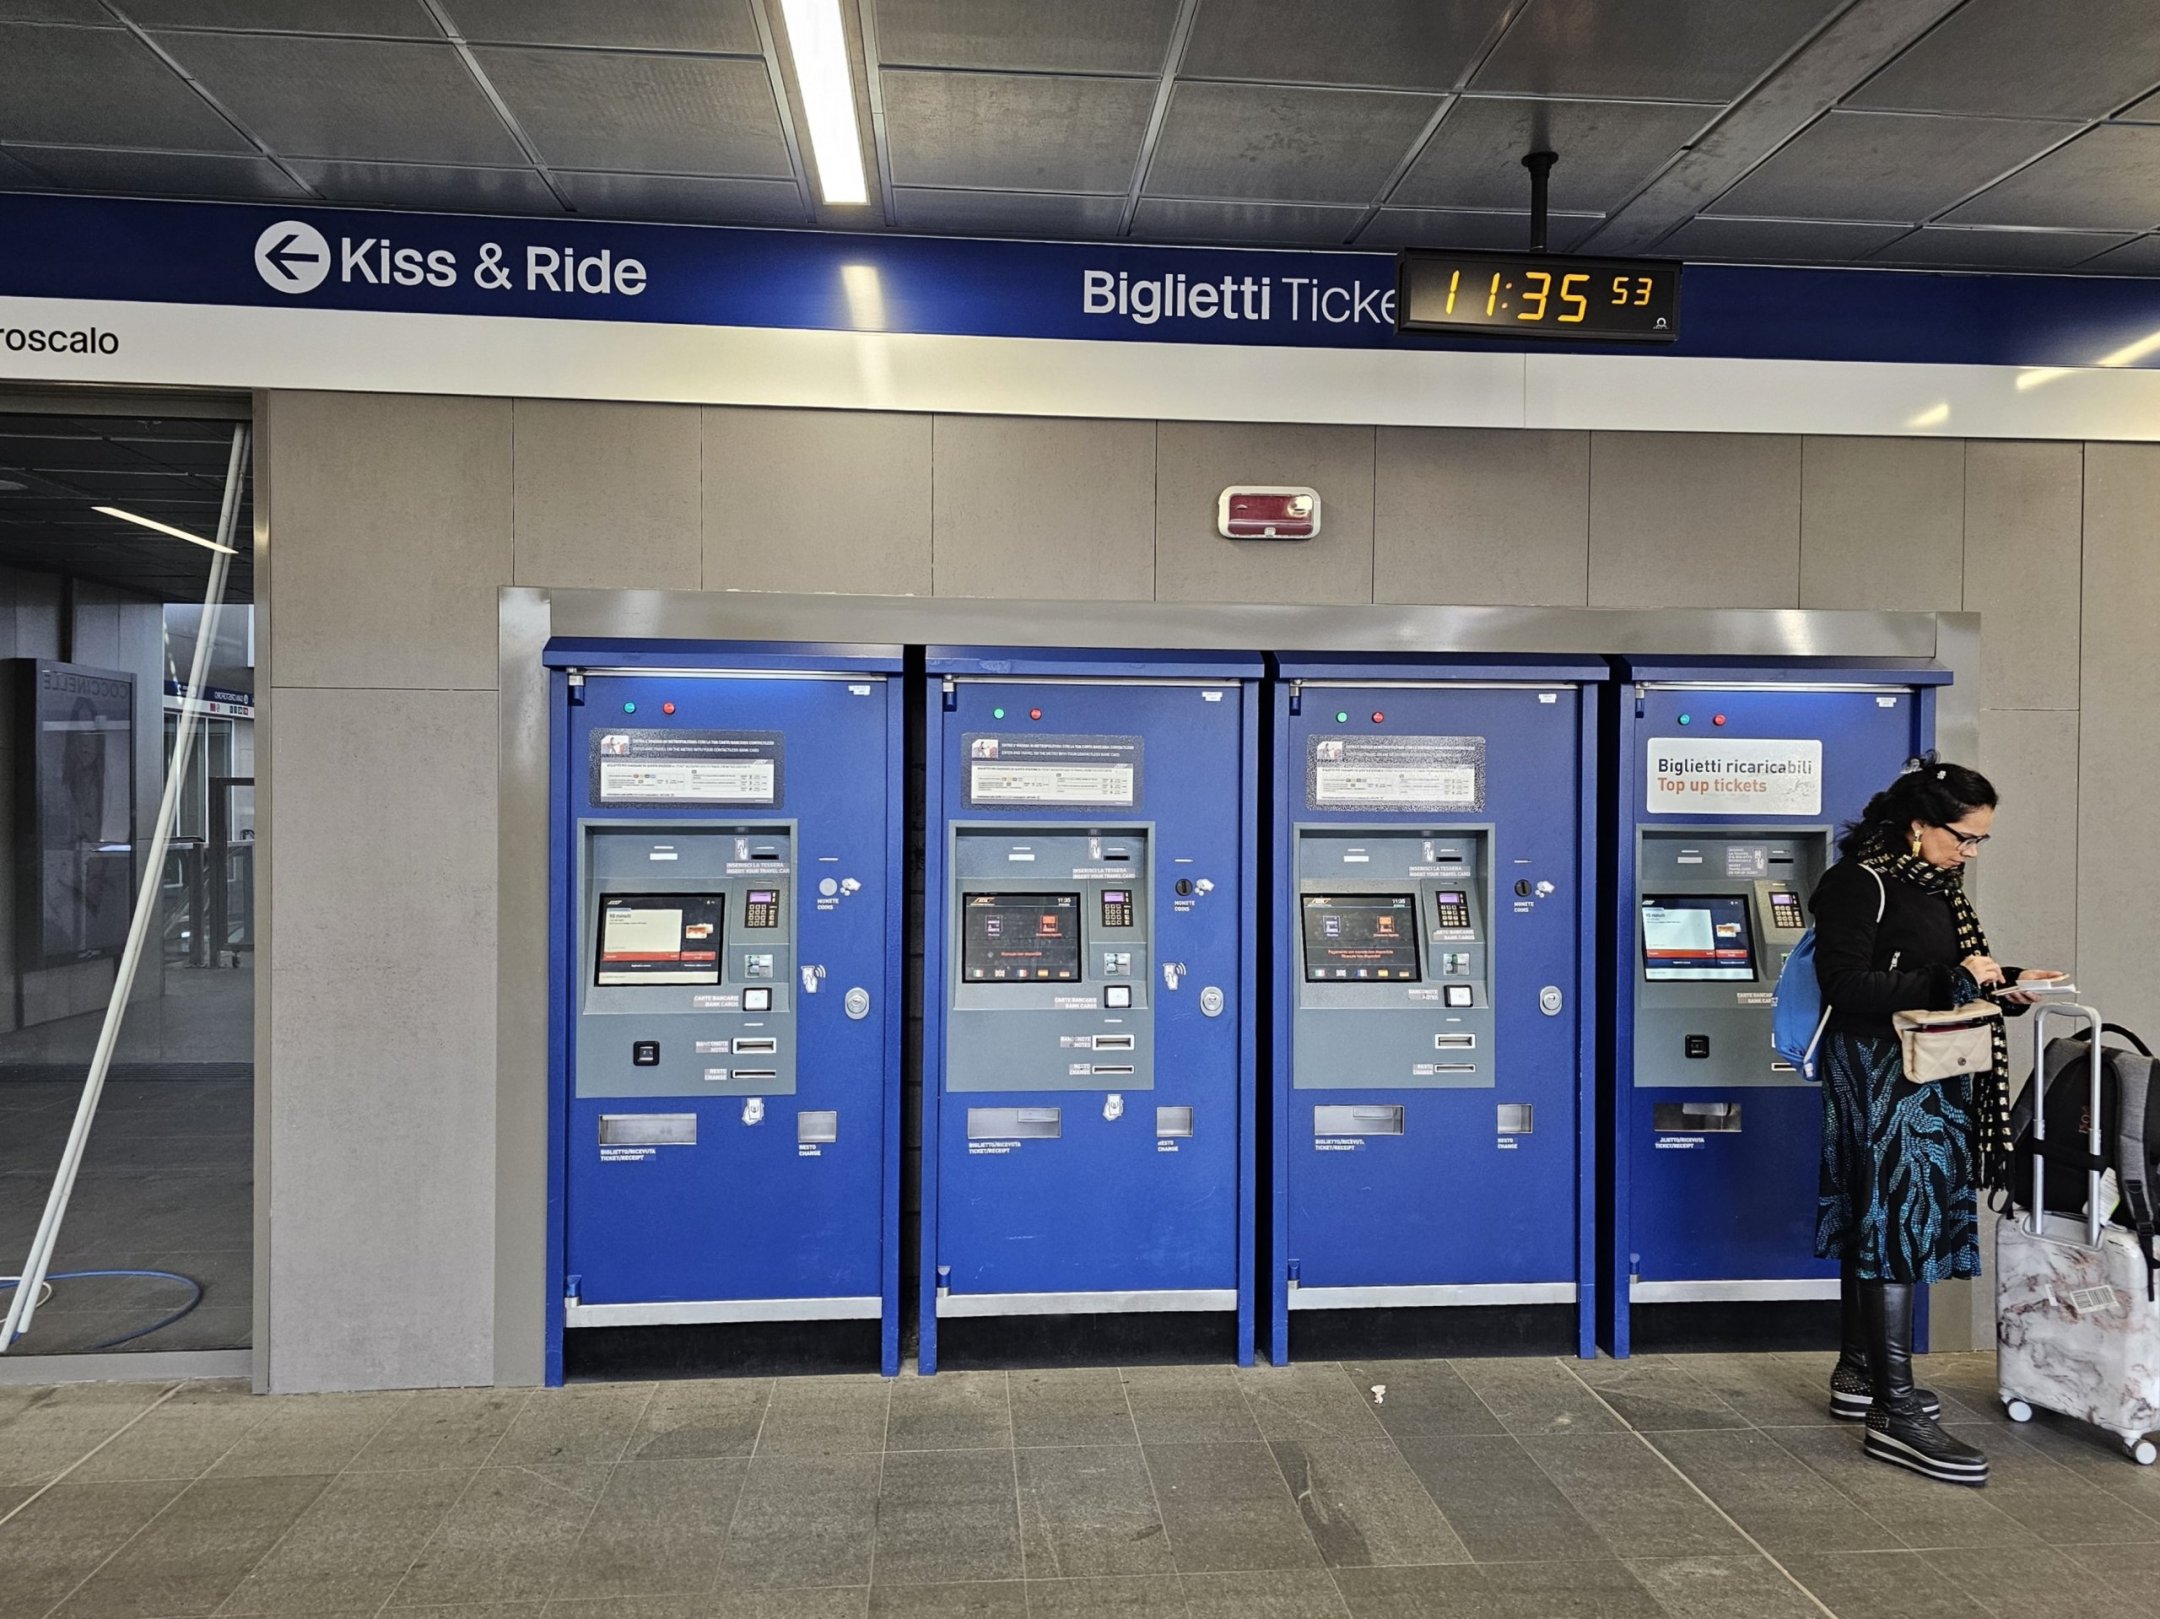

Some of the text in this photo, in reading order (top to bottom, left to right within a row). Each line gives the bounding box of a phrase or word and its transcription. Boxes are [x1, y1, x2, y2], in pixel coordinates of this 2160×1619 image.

[341, 237, 647, 296] Kiss & Ride
[1083, 269, 1271, 325] Biglietti
[1445, 269, 1653, 323] 11:35 53
[1657, 777, 1768, 795] Top up tickets
[1658, 758, 1812, 776] Biglietti ricaricabili
